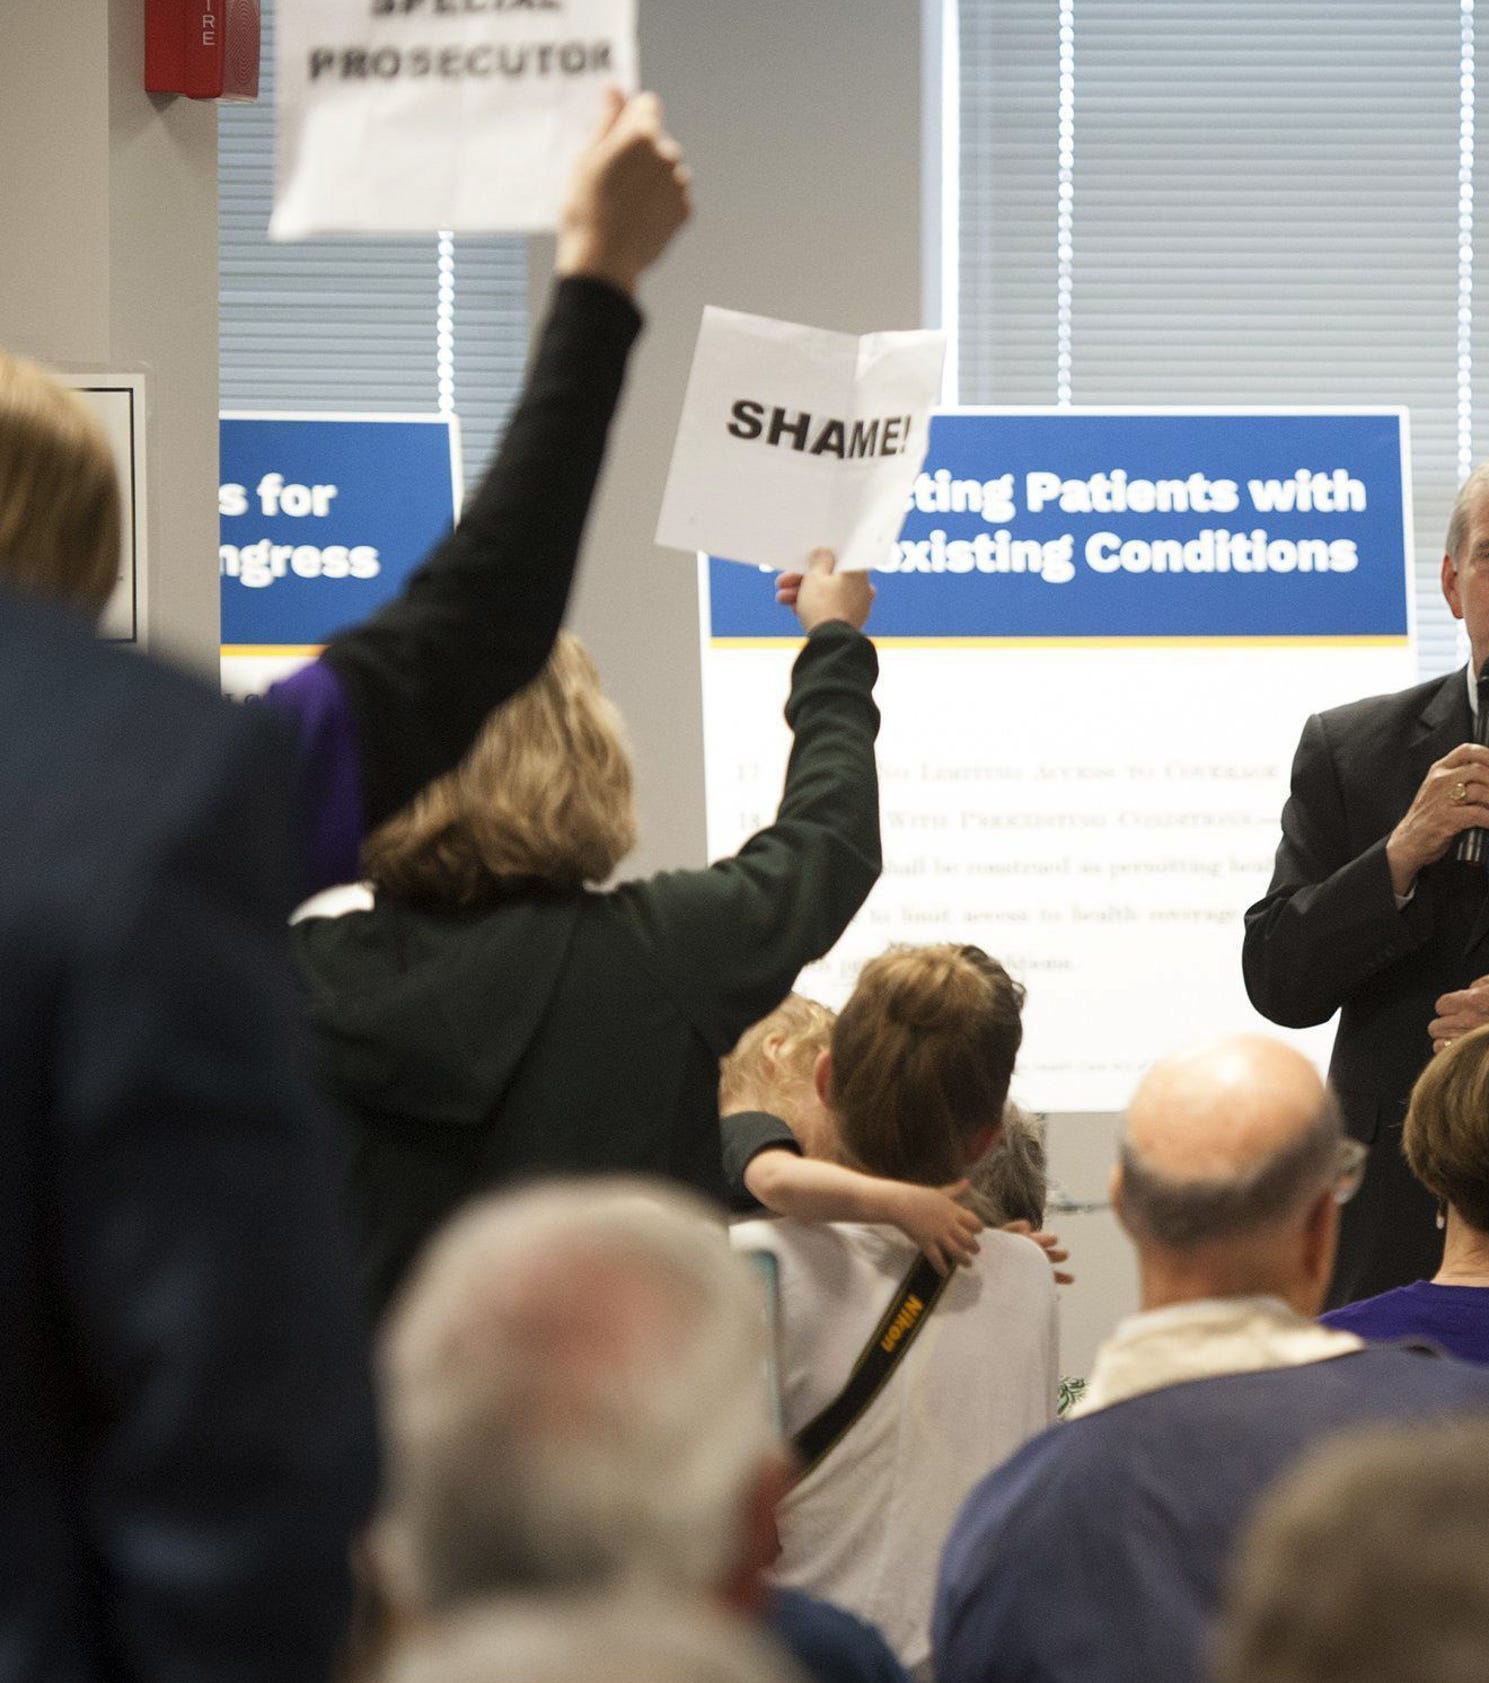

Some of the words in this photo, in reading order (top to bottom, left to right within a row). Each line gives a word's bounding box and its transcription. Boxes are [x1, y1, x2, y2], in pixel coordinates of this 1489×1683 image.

[308, 42, 611, 81] PROSECUTOR
[726, 399, 909, 461] SHAME!
[257, 472, 338, 517] for
[1026, 469, 1239, 512] Patients
[1247, 469, 1366, 513] with
[1085, 530, 1358, 574] Conditions
[879, 1295, 924, 1353] Nikon
